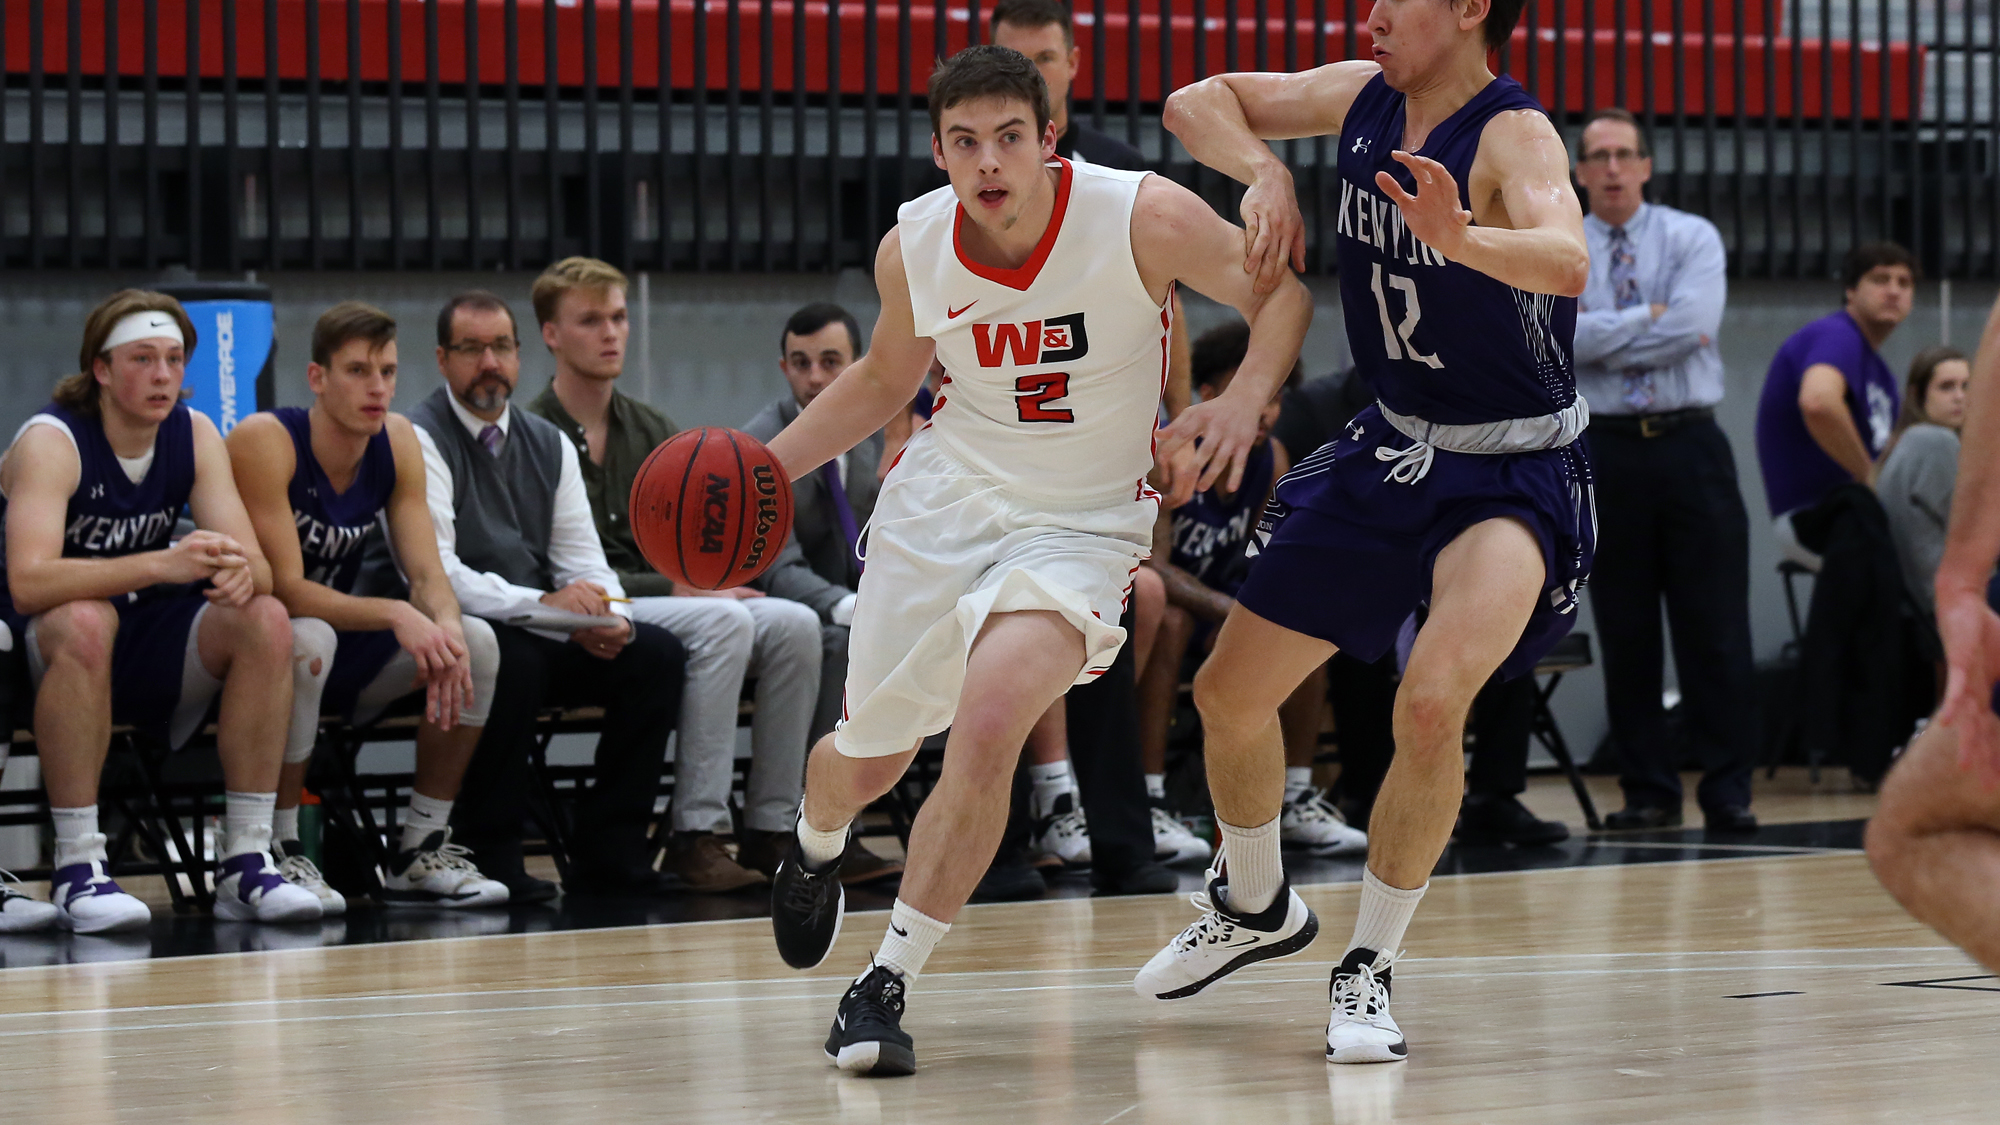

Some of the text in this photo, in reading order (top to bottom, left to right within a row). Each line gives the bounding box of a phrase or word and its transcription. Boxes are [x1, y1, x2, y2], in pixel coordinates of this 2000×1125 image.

[971, 312, 1089, 368] W&J
[1371, 262, 1445, 369] 12
[216, 309, 238, 438] OWERADE
[1015, 372, 1075, 424] 2
[65, 506, 175, 551] KENYON
[294, 509, 376, 559] KENY
[700, 472, 731, 554] NCAA
[739, 464, 778, 571] Wilson
